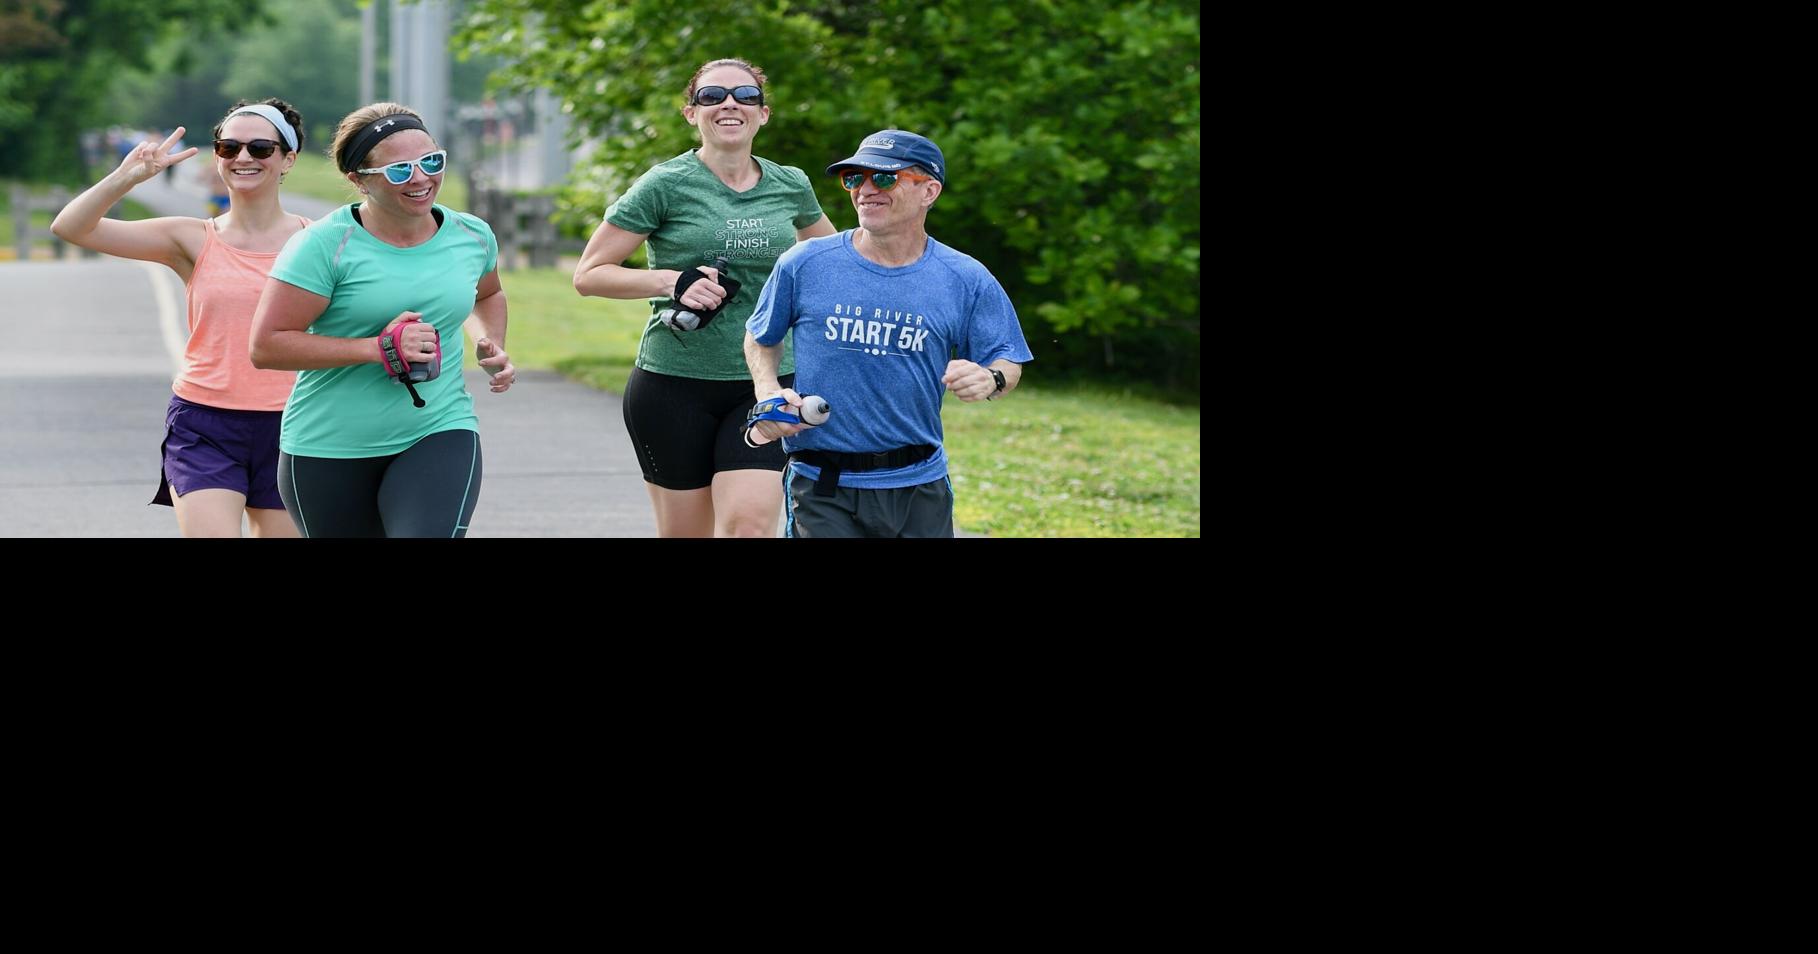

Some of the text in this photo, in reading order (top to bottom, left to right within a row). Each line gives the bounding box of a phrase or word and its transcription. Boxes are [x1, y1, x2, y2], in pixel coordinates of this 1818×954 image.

[726, 218, 764, 229] START
[715, 227, 778, 241] STRONG
[726, 238, 769, 250] FINISH
[834, 303, 923, 326] BIG RIVER
[824, 316, 929, 352] START 5K
